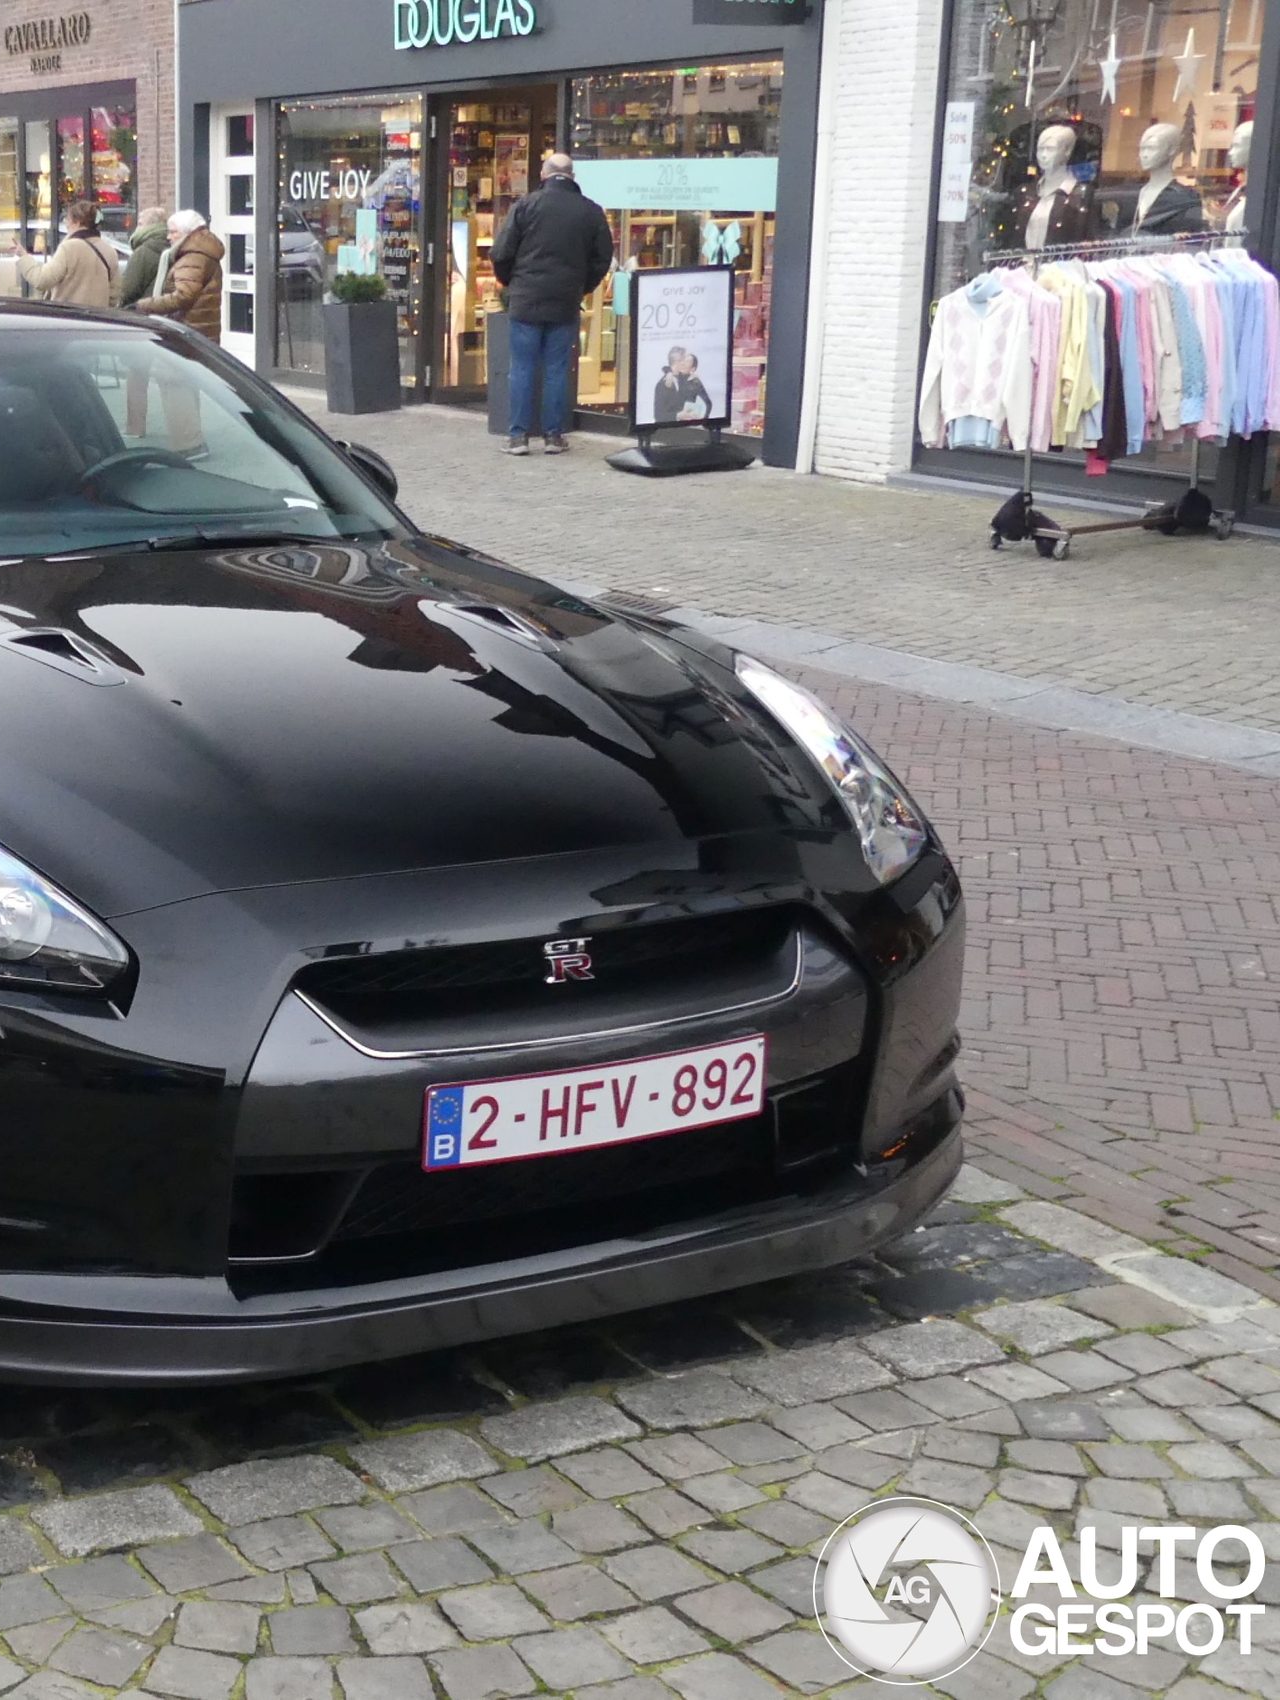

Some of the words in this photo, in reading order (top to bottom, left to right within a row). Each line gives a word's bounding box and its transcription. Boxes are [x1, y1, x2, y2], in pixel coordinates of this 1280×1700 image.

[5, 12, 90, 54] CAVALLARO
[394, 0, 535, 50] DOUGLAS
[290, 171, 329, 200] GIVE
[334, 170, 371, 199] JOY
[663, 287, 684, 296] GIVE
[687, 286, 705, 295] JOY
[433, 1134, 455, 1160] B
[467, 1052, 757, 1150] 2-HFV-892
